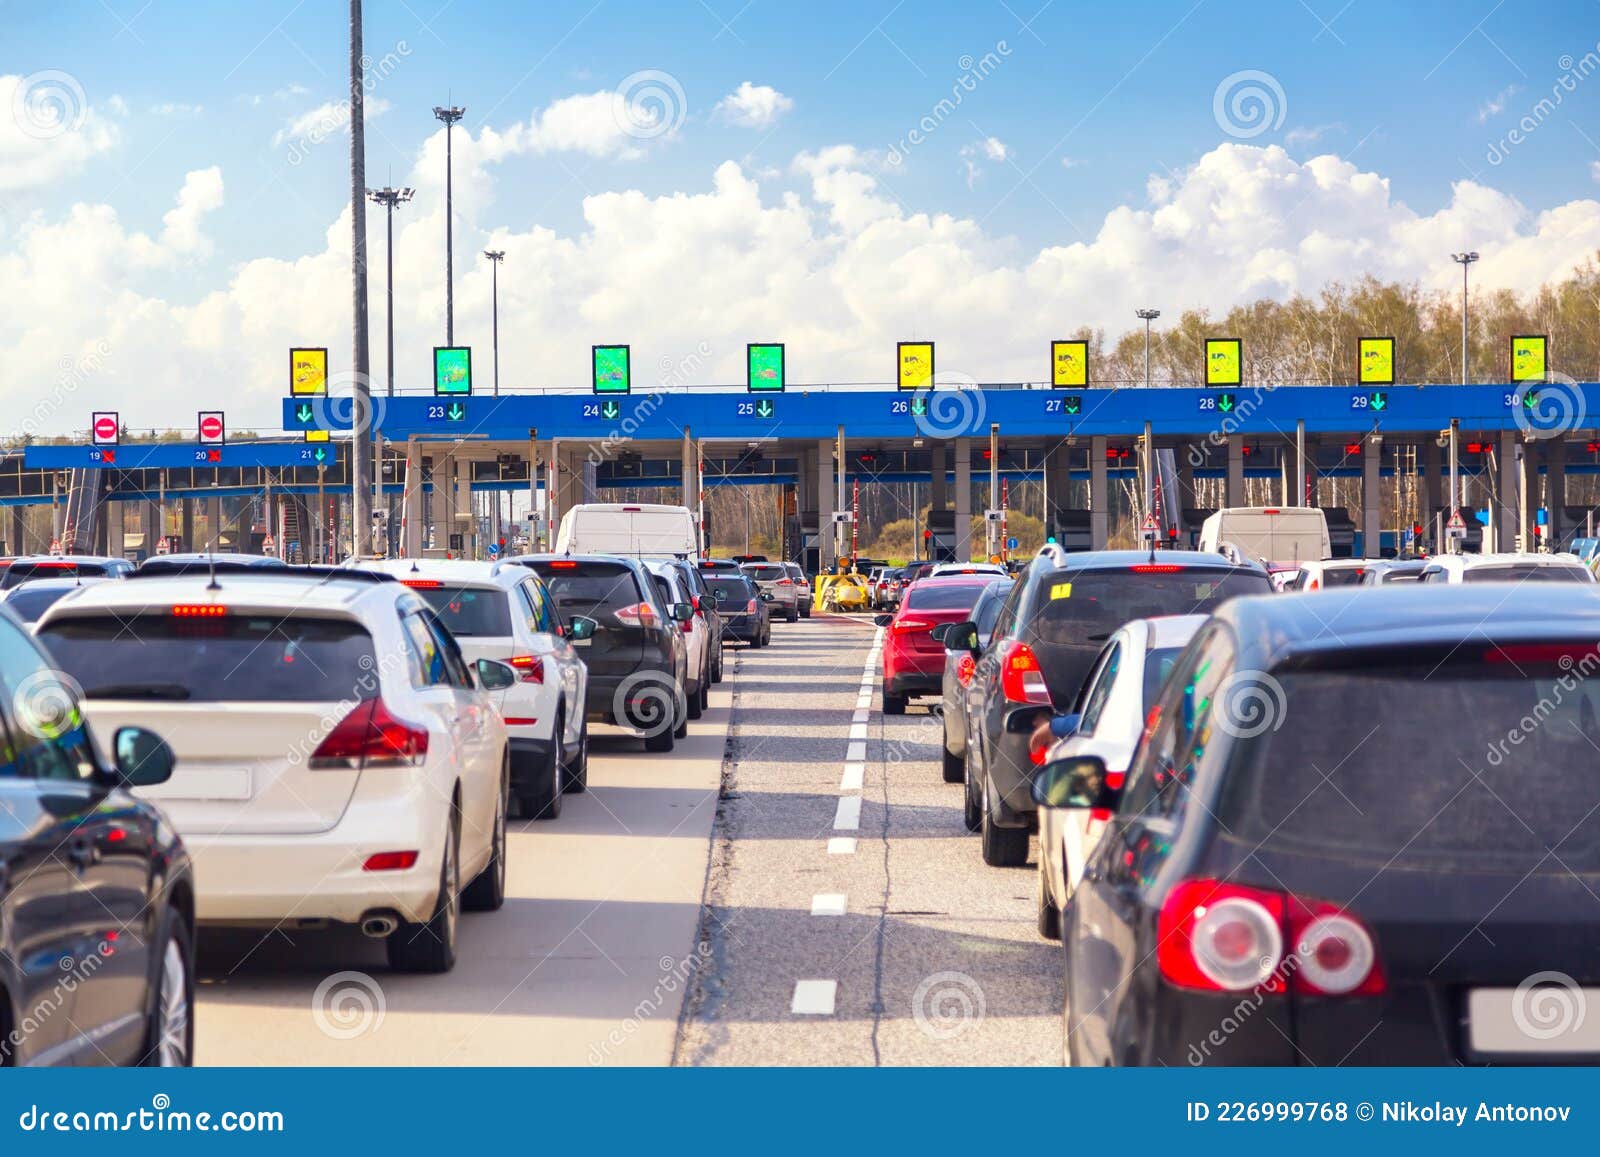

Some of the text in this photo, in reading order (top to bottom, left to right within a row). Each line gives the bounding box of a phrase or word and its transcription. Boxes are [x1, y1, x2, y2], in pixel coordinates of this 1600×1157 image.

[1199, 398, 1215, 410] 28
[1352, 397, 1368, 408] 29
[1504, 394, 1520, 406] 30
[583, 405, 599, 416] 24
[738, 403, 754, 415] 25
[892, 402, 908, 413] 26
[1046, 400, 1061, 412] 27
[429, 406, 444, 418] 23
[89, 451, 100, 460] 19
[195, 451, 206, 460] 20
[301, 450, 312, 459] 21
